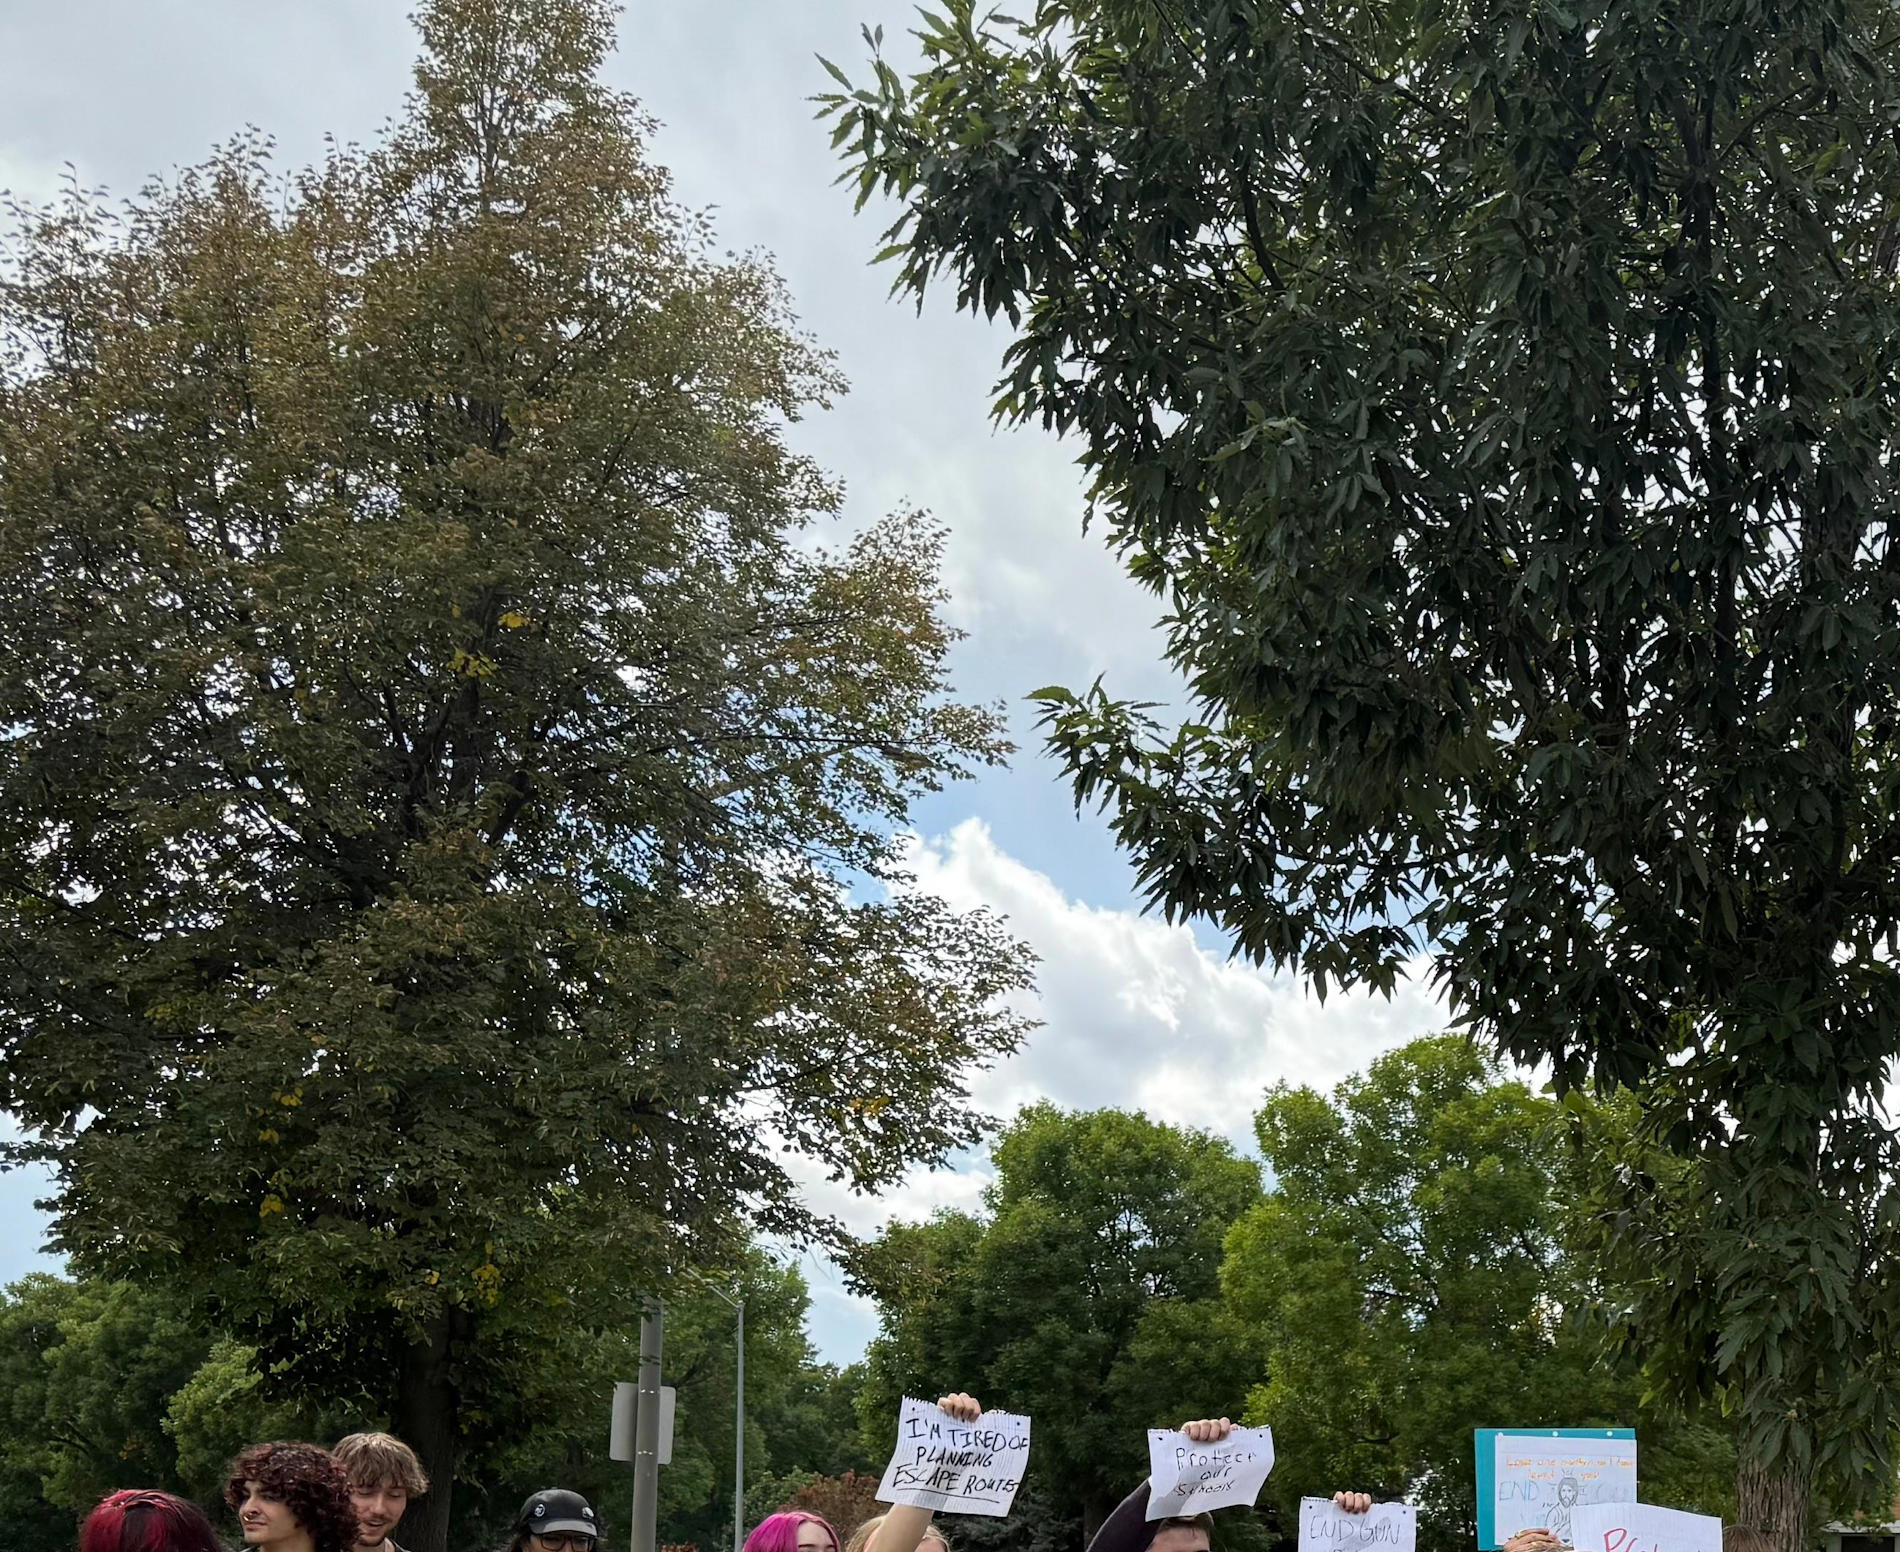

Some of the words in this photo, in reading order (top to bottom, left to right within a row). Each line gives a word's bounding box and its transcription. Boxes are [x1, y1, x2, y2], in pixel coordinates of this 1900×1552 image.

[906, 1417, 941, 1440] I'M
[947, 1428, 1006, 1452] TIRED
[1009, 1435, 1029, 1450] OF
[916, 1446, 994, 1467] PLANNING
[892, 1463, 961, 1490] ESCAPE
[1499, 1480, 1540, 1501] END
[1311, 1515, 1354, 1541] END
[1360, 1518, 1400, 1544] GUN
